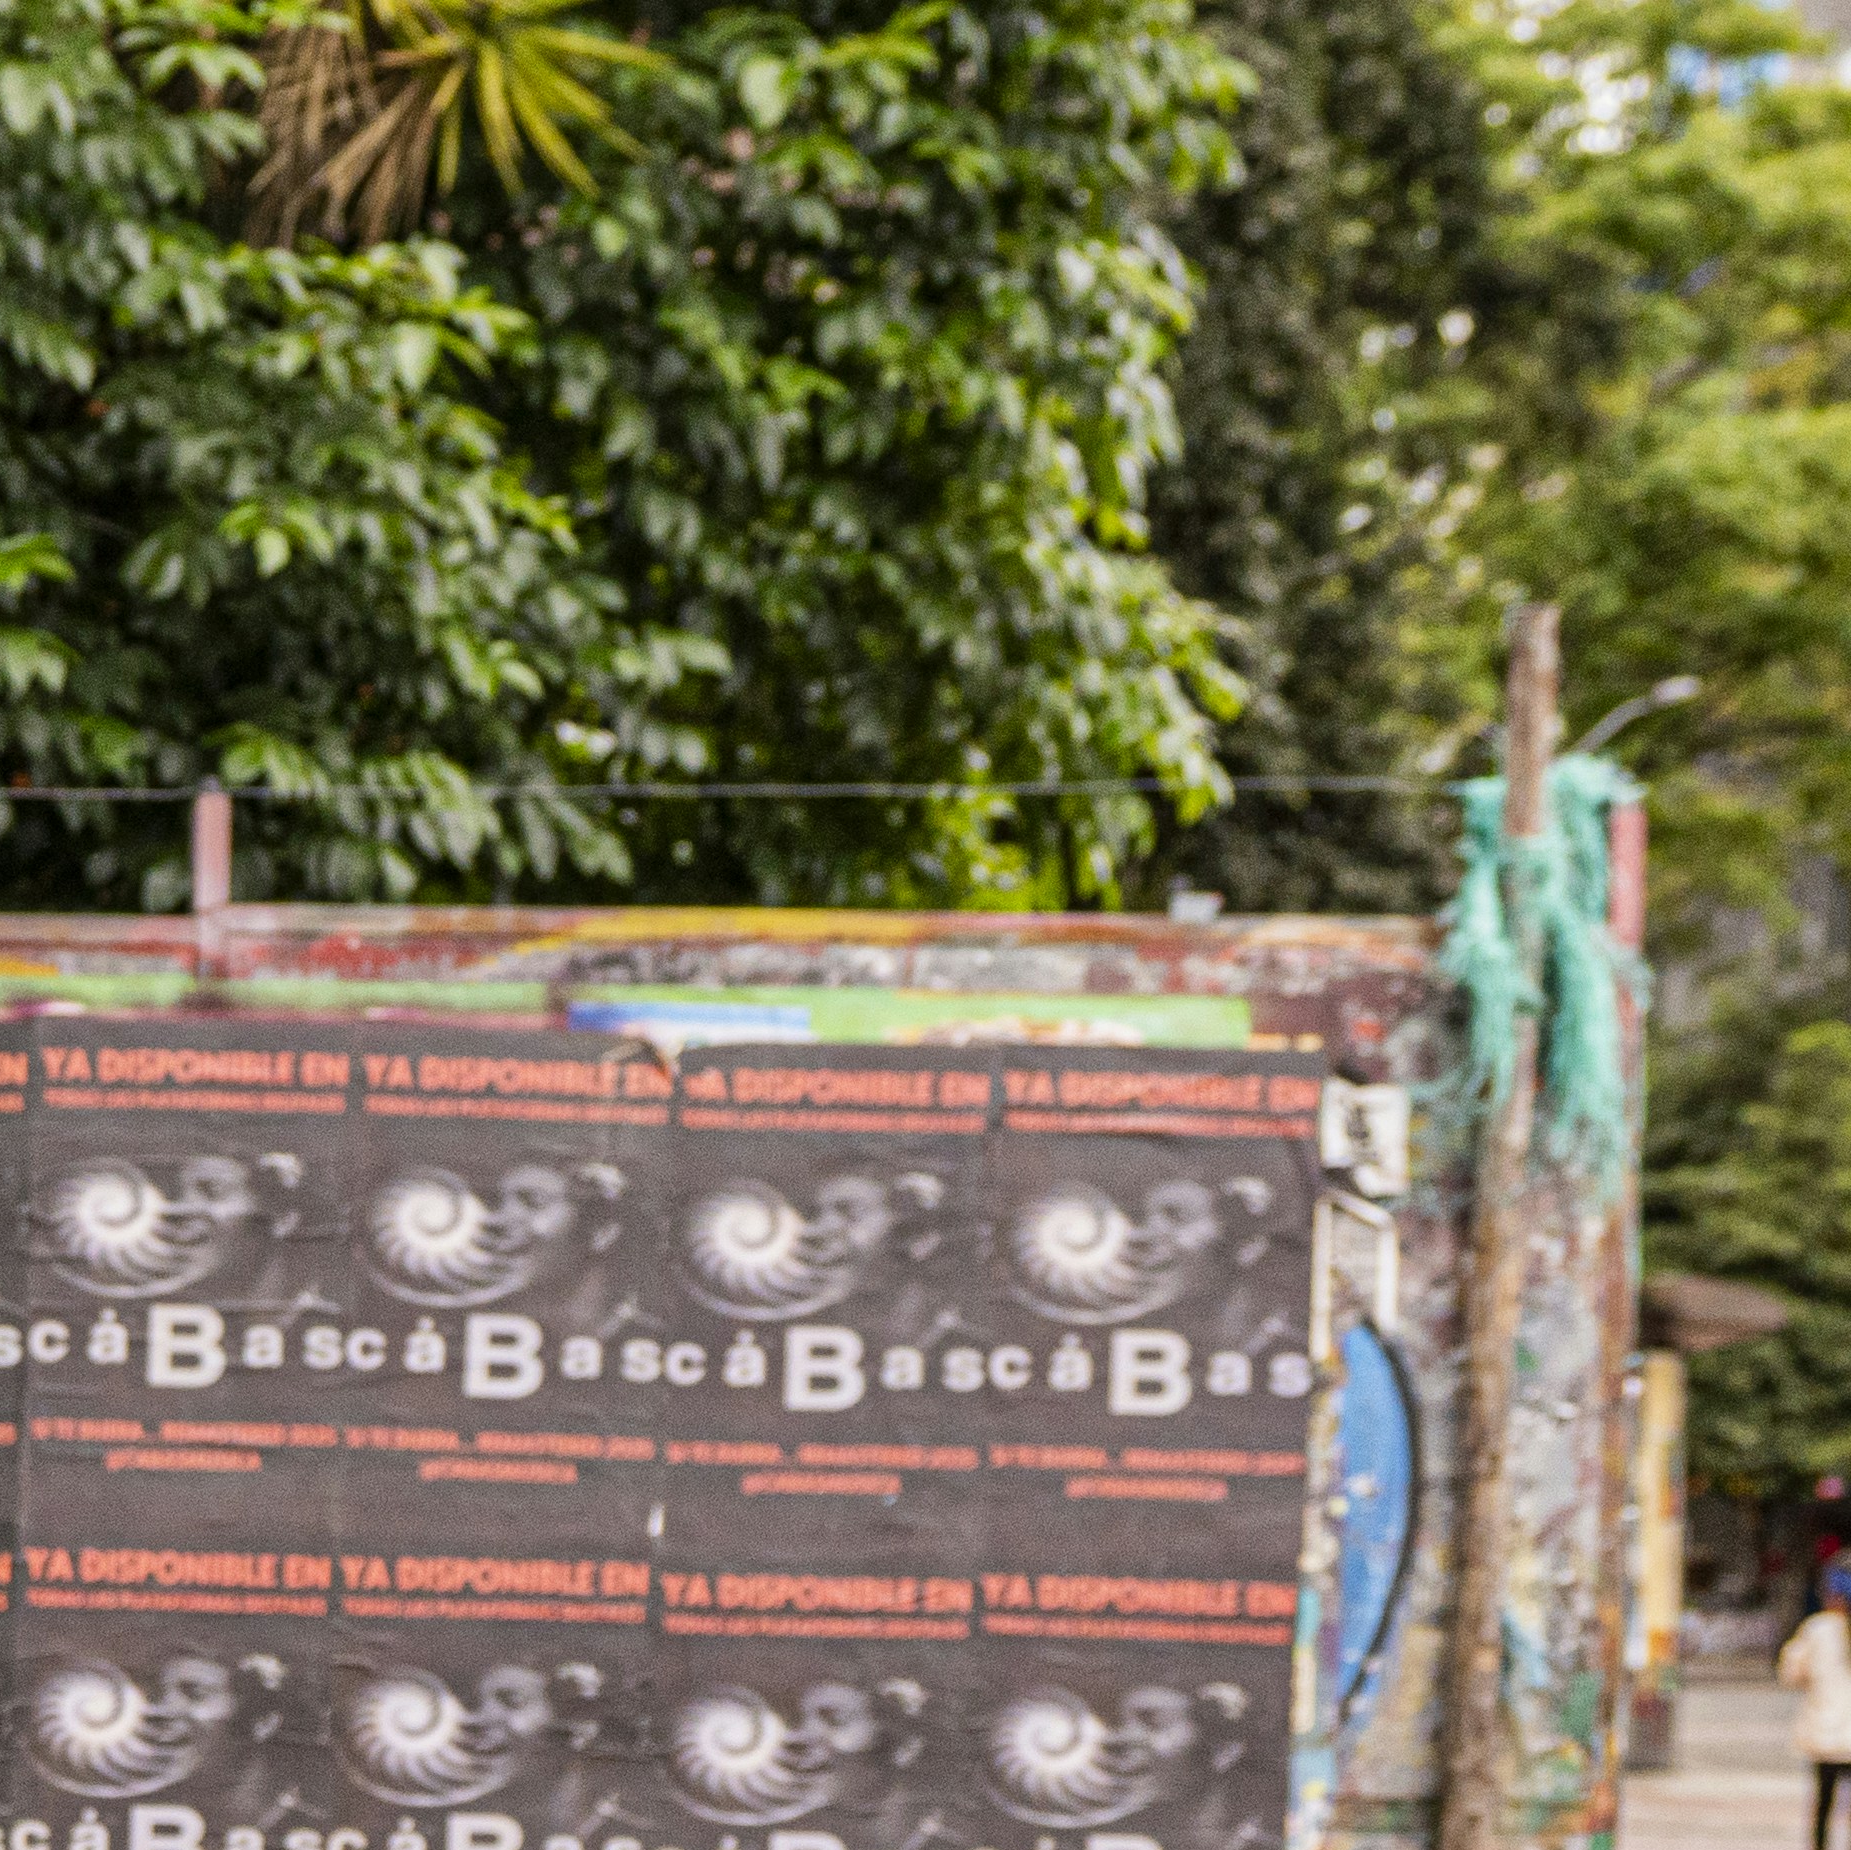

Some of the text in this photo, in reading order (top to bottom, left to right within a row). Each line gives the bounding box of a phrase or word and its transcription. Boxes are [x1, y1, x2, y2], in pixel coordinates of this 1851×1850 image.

[44, 1048, 349, 1085] YA DISPONIBLE EN
[366, 1056, 412, 1086] YA
[419, 1057, 618, 1095] DISPONIBLE
[733, 1067, 934, 1105] DISPONIBLE
[939, 1072, 989, 1106] EN
[1004, 1070, 1053, 1102] YA
[1267, 1077, 1320, 1110] EN
[26, 1548, 332, 1588] YA DISPONIBLE EN
[341, 1557, 650, 1595] YA DISPONIBLE EN
[662, 1574, 973, 1612] YA DISPONIBLE EN
[983, 1575, 1296, 1617] YA DISPONIBLE EN
